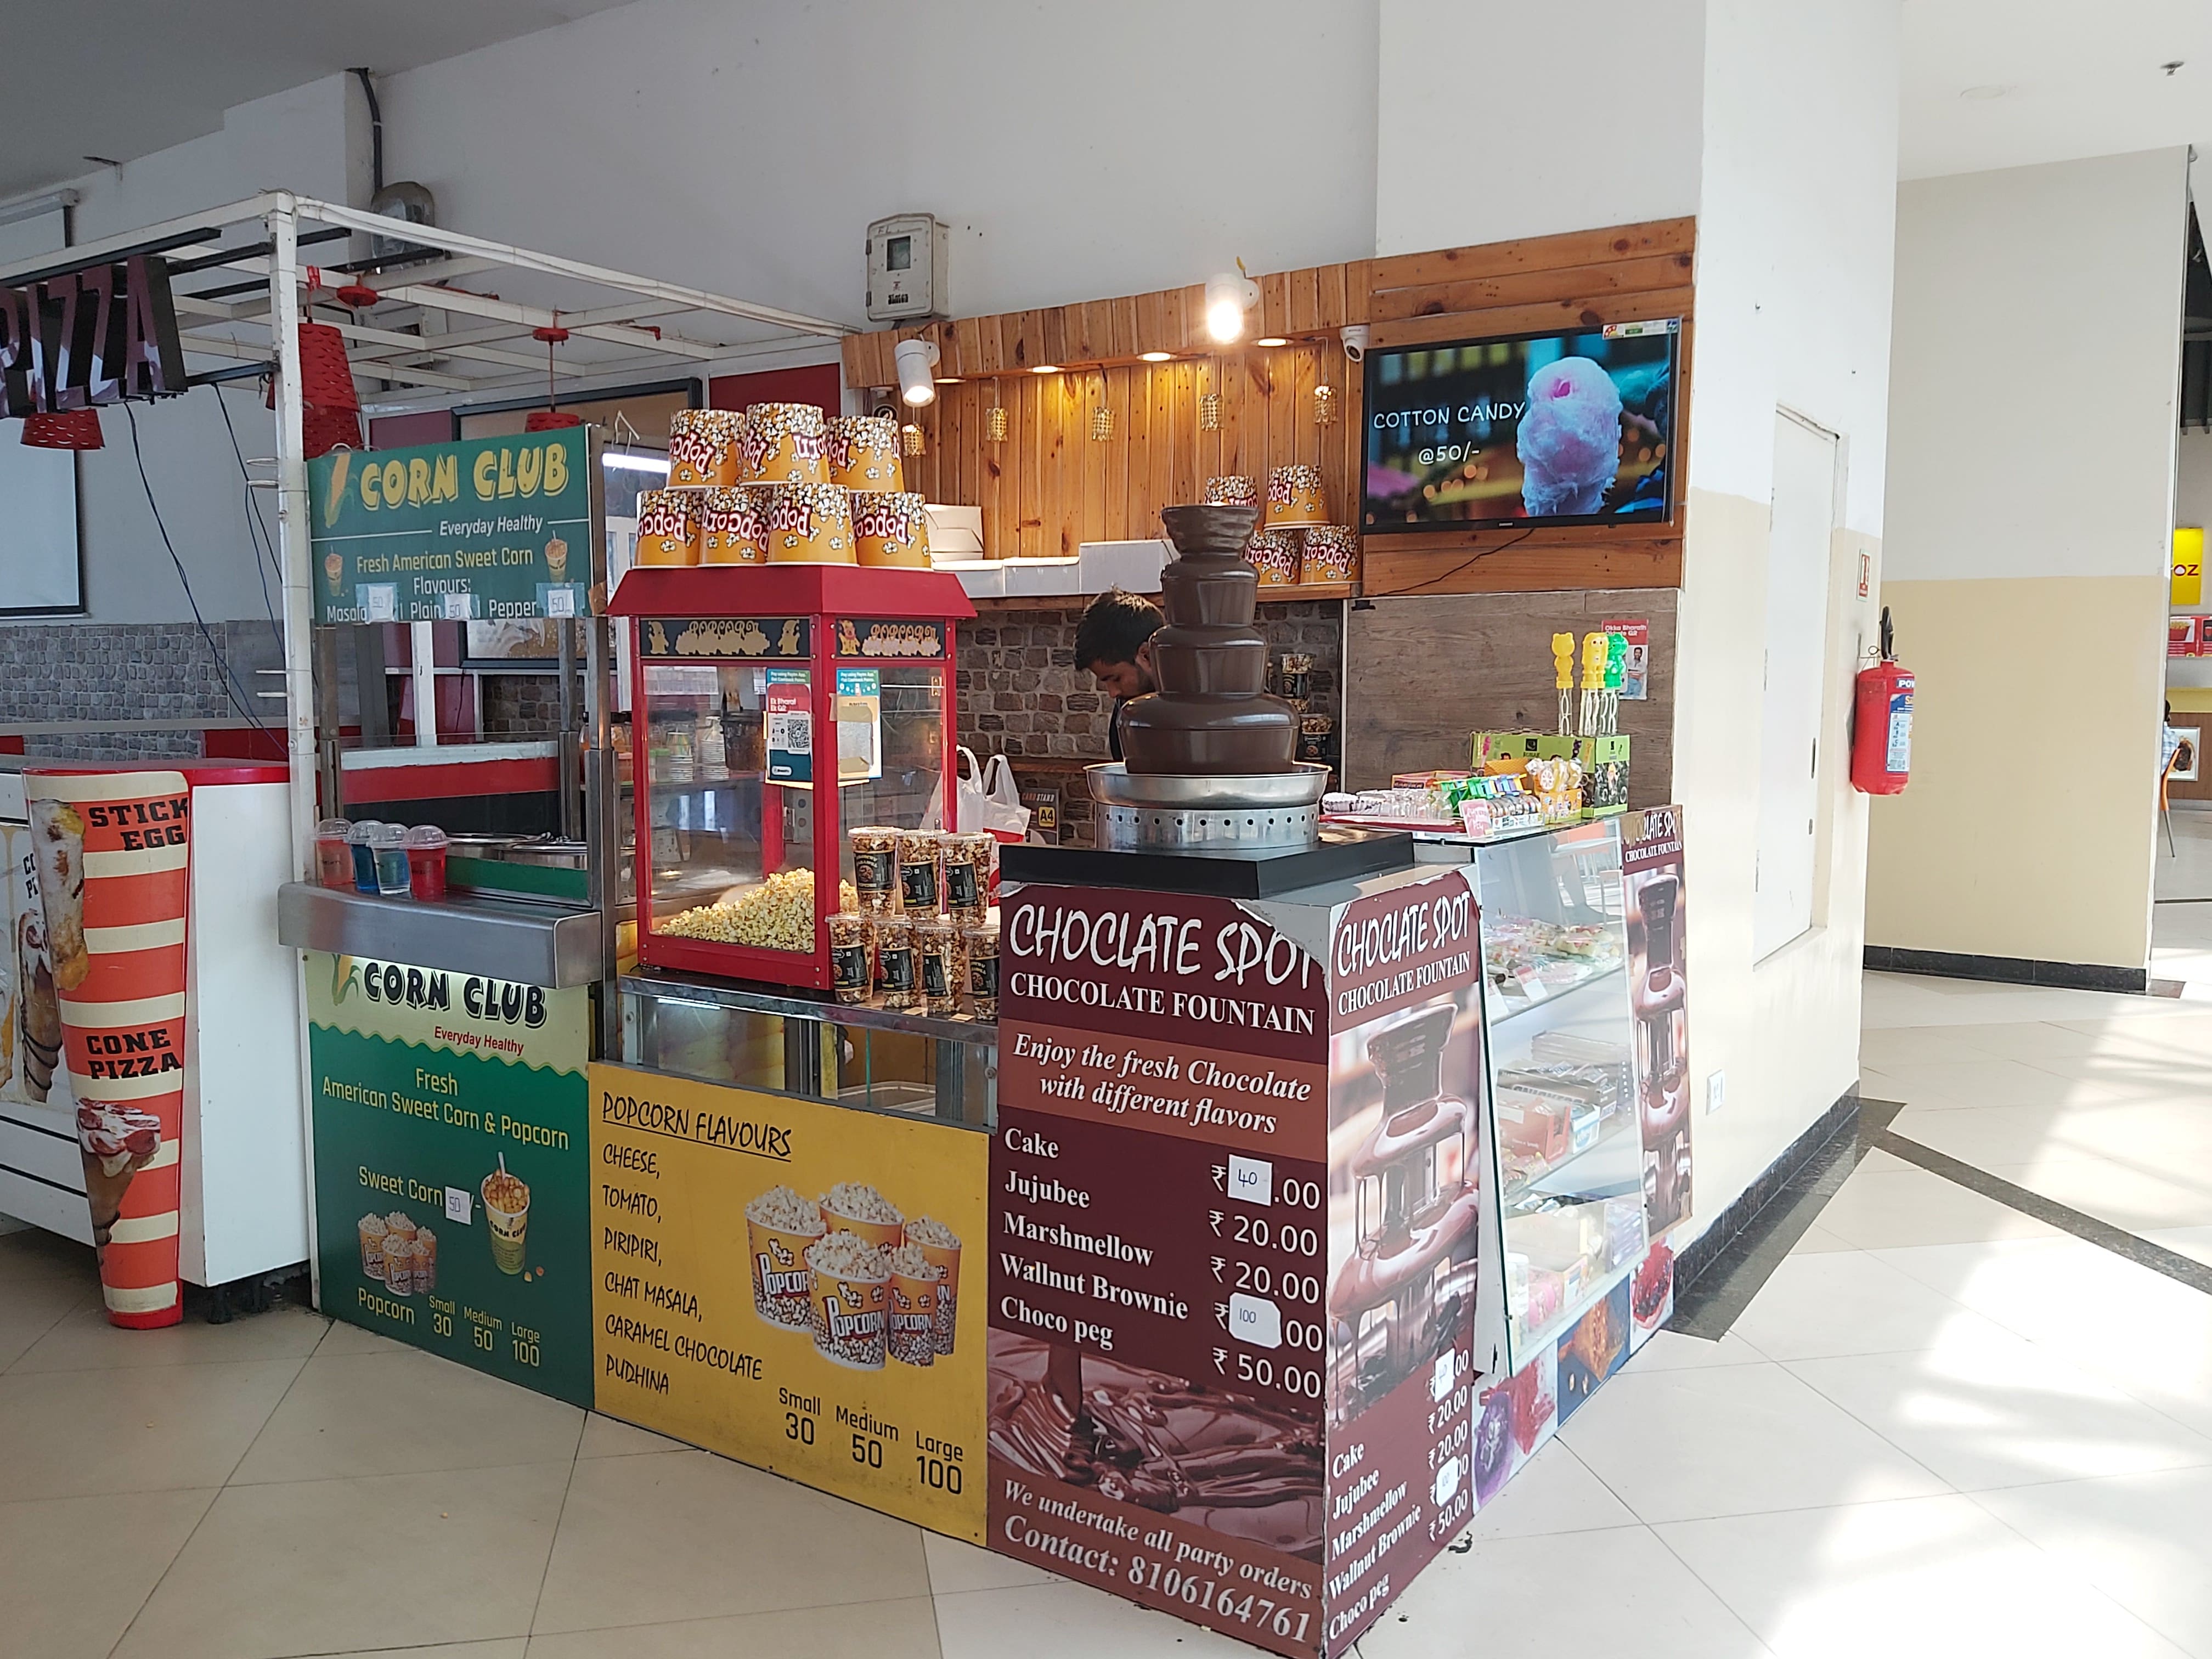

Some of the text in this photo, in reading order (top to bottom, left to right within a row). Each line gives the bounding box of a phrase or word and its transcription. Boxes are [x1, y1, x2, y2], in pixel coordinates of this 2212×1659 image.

[1374, 401, 1525, 429] COTTON CANDY
[360, 443, 569, 511] CORN CLUB
[1418, 441, 1480, 465] @50/-
[439, 515, 543, 538] Everyday Healthy
[357, 548, 533, 573] Fresh American Sweet Corn
[411, 601, 440, 619] Plain
[489, 599, 537, 618] Pepper
[414, 577, 471, 595] Flavours:
[89, 797, 188, 827] STICK
[1040, 809, 1054, 822] A4
[120, 825, 186, 851] EGG
[1626, 845, 1657, 863] CHOCOLATE
[1010, 904, 1201, 975] CHOCLATE
[1338, 891, 1470, 977] CHOCLATE SPOT
[364, 962, 547, 1028] CORN CLUB
[1011, 973, 1315, 1035] CHOCOLATE FOUNTAIN
[1338, 951, 1470, 1015] CHOCOLATE FOUNTAIN
[86, 1029, 171, 1055] CONE
[87, 1052, 183, 1079] PIZZA
[435, 1026, 524, 1056] Everyday Healthy
[415, 1068, 458, 1096] Fresh
[1013, 1033, 1311, 1101] Enjoy the fresh Chocolate
[323, 1076, 569, 1150] American Sweet Corn & Popcorn
[602, 1092, 792, 1157] POPCORN FLAVOURS
[1040, 1075, 1277, 1133] with different flavors
[602, 1143, 661, 1180] CHEESE,
[1005, 1128, 1059, 1158] Cake
[358, 1166, 443, 1207] Sweet Corn
[1238, 1169, 1257, 1188] 40
[602, 1184, 662, 1224] TOMATO,
[1005, 1170, 1090, 1208] Jujubee
[1234, 1216, 1318, 1256] 20.00
[603, 1227, 662, 1266] PIRIPIRI,
[1003, 1211, 1154, 1267] Marshmellow
[1235, 1262, 1319, 1304] 20.00
[358, 1287, 415, 1325] Popcorn
[605, 1271, 703, 1323] CHAT MASALA,
[1000, 1253, 1086, 1294] Wallnut
[1092, 1274, 1188, 1320] Brownie
[429, 1295, 540, 1344] Small Medium Large
[1239, 1308, 1256, 1323] 100
[433, 1314, 540, 1368] 30 50 100
[605, 1314, 763, 1380] CARAMEL CHOCOLATE
[1001, 1296, 1068, 1333] Choco
[1074, 1319, 1113, 1351] peg
[1238, 1353, 1322, 1398] 50.00
[605, 1354, 669, 1395] PUDHINA
[779, 1387, 964, 1463] Small Medium Large
[785, 1413, 962, 1495] 30 50 100
[1333, 1469, 1380, 1520] Jujubee
[1437, 1385, 1467, 1428] 20.00
[1333, 1442, 1364, 1479] Cake
[1331, 1481, 1407, 1561] Marshmellow
[1437, 1420, 1468, 1464] 20.00
[1005, 1480, 1312, 1600] We undertake all party orders
[1329, 1548, 1376, 1600] Wallnut
[1378, 1504, 1421, 1559] Brownie
[1329, 1594, 1367, 1640] Choco
[1369, 1573, 1390, 1610] peg
[1438, 1489, 1468, 1534] 50.00
[1005, 1515, 1311, 1643] Contact: 8106164761
